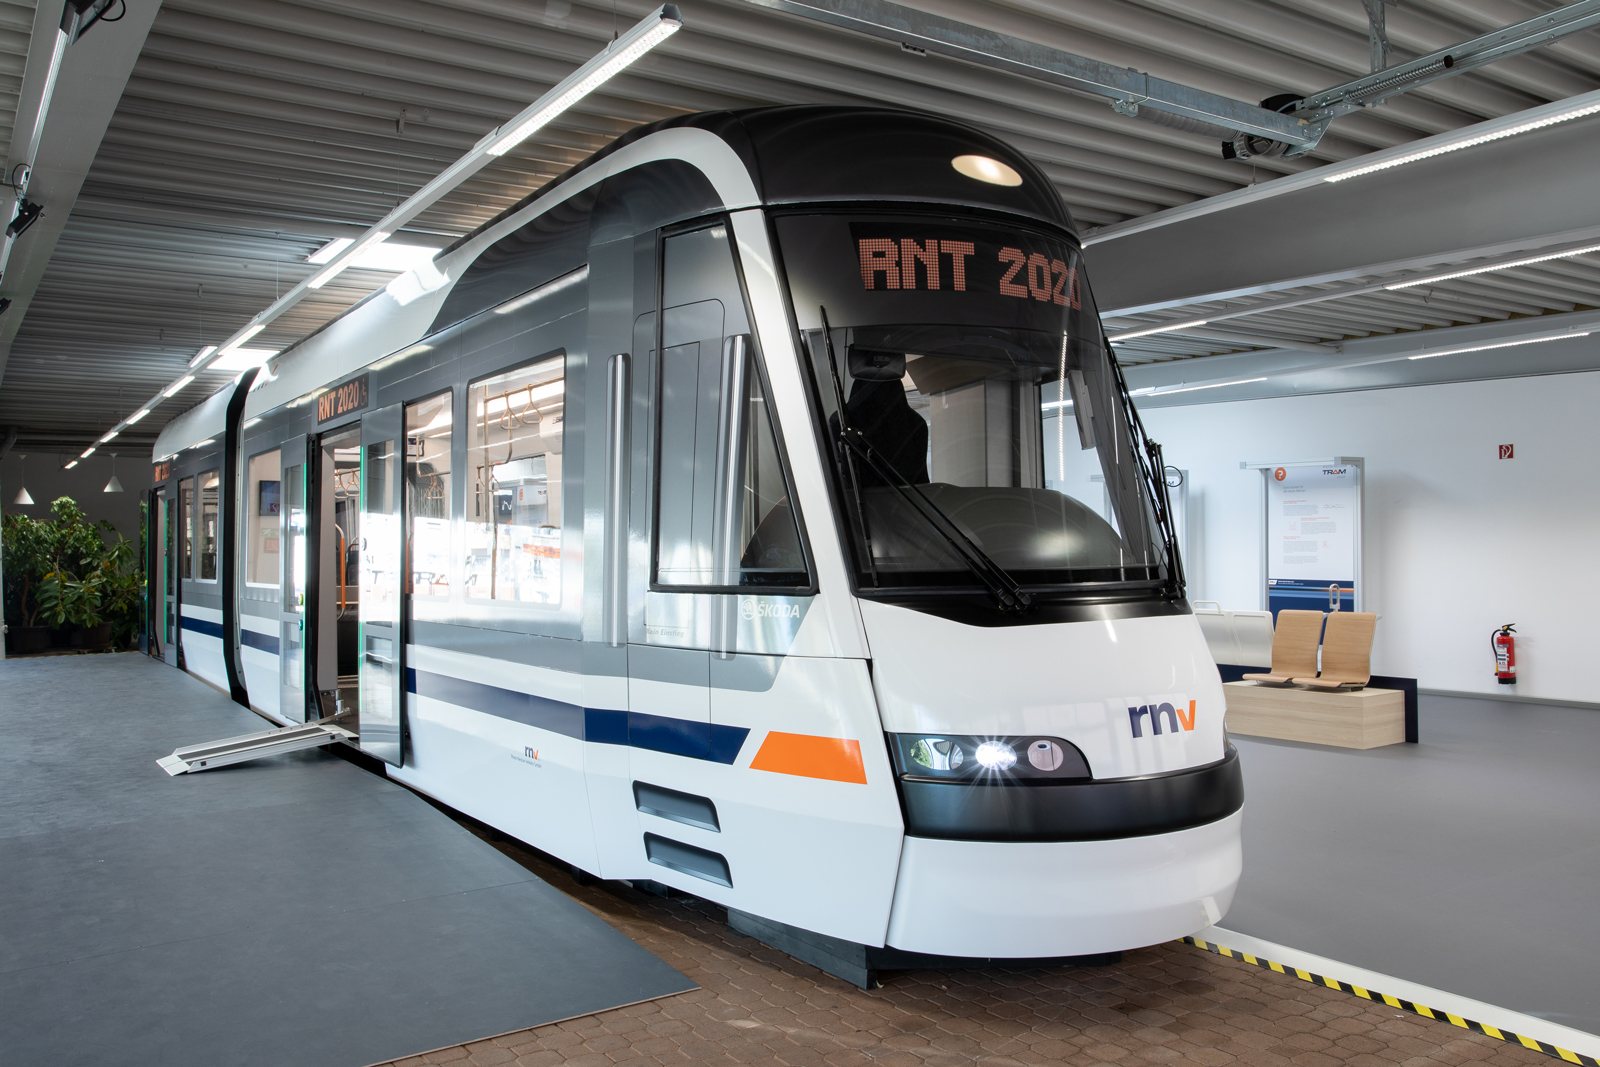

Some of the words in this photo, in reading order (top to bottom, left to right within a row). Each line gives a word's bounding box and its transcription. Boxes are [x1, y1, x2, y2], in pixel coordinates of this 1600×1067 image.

[859, 239, 975, 291] RNT
[998, 246, 1081, 311] 2020
[318, 391, 336, 421] RNT
[337, 381, 359, 414] 2020
[758, 601, 800, 618] ŠKODA
[660, 628, 685, 638] Einstieg
[1128, 700, 1196, 739] rnv
[525, 746, 539, 760] rnv
